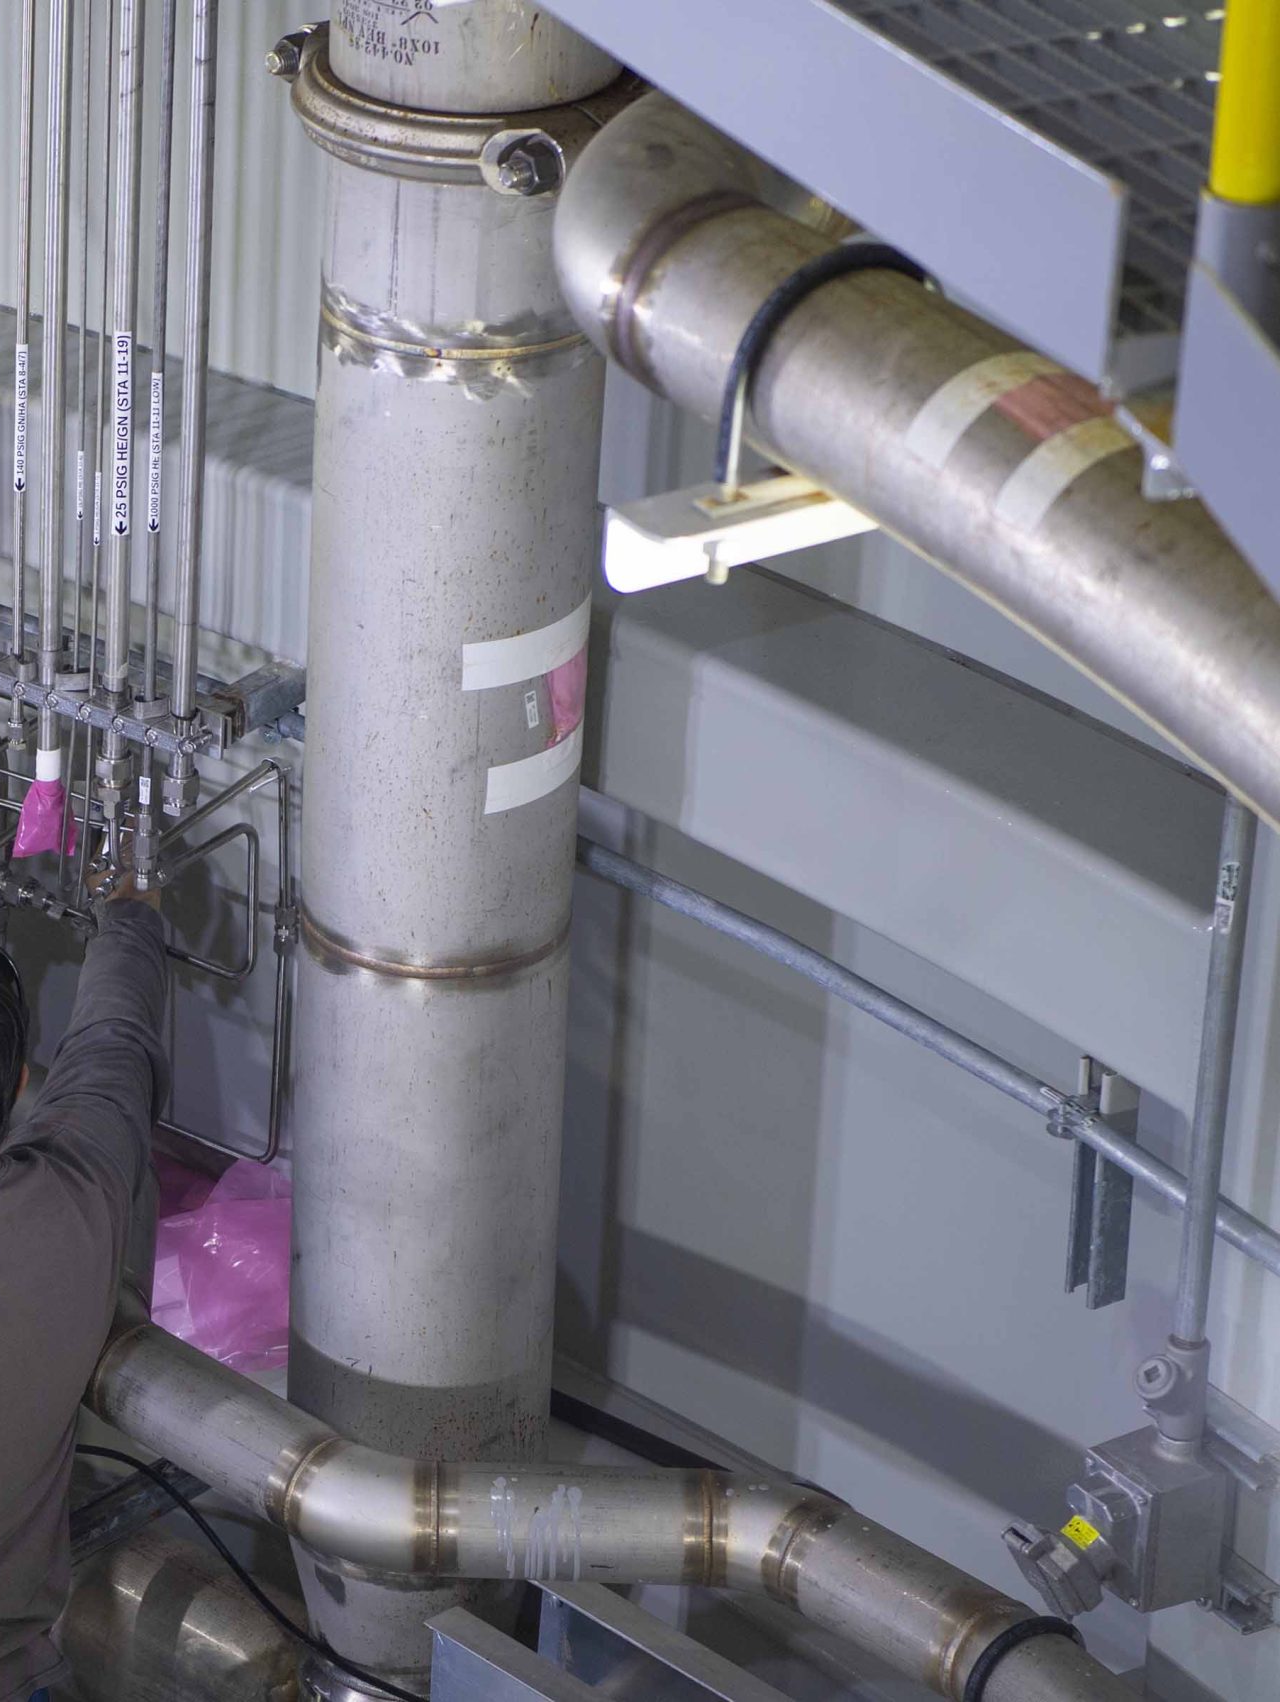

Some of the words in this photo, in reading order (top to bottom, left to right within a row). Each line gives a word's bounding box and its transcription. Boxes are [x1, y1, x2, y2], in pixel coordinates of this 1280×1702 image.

[117, 335, 130, 375] 11-19)
[17, 379, 27, 399] (STA
[117, 380, 131, 411] (STA
[17, 403, 26, 432] GN/HA
[16, 435, 25, 457] PSIG
[117, 416, 129, 461] HE/GN
[151, 433, 161, 454] (STA
[16, 460, 24, 474] 140
[151, 457, 160, 469] HE
[116, 466, 128, 498] PSIG
[151, 472, 160, 495] PSIG
[116, 503, 127, 518] 25
[150, 498, 159, 517] 1000
